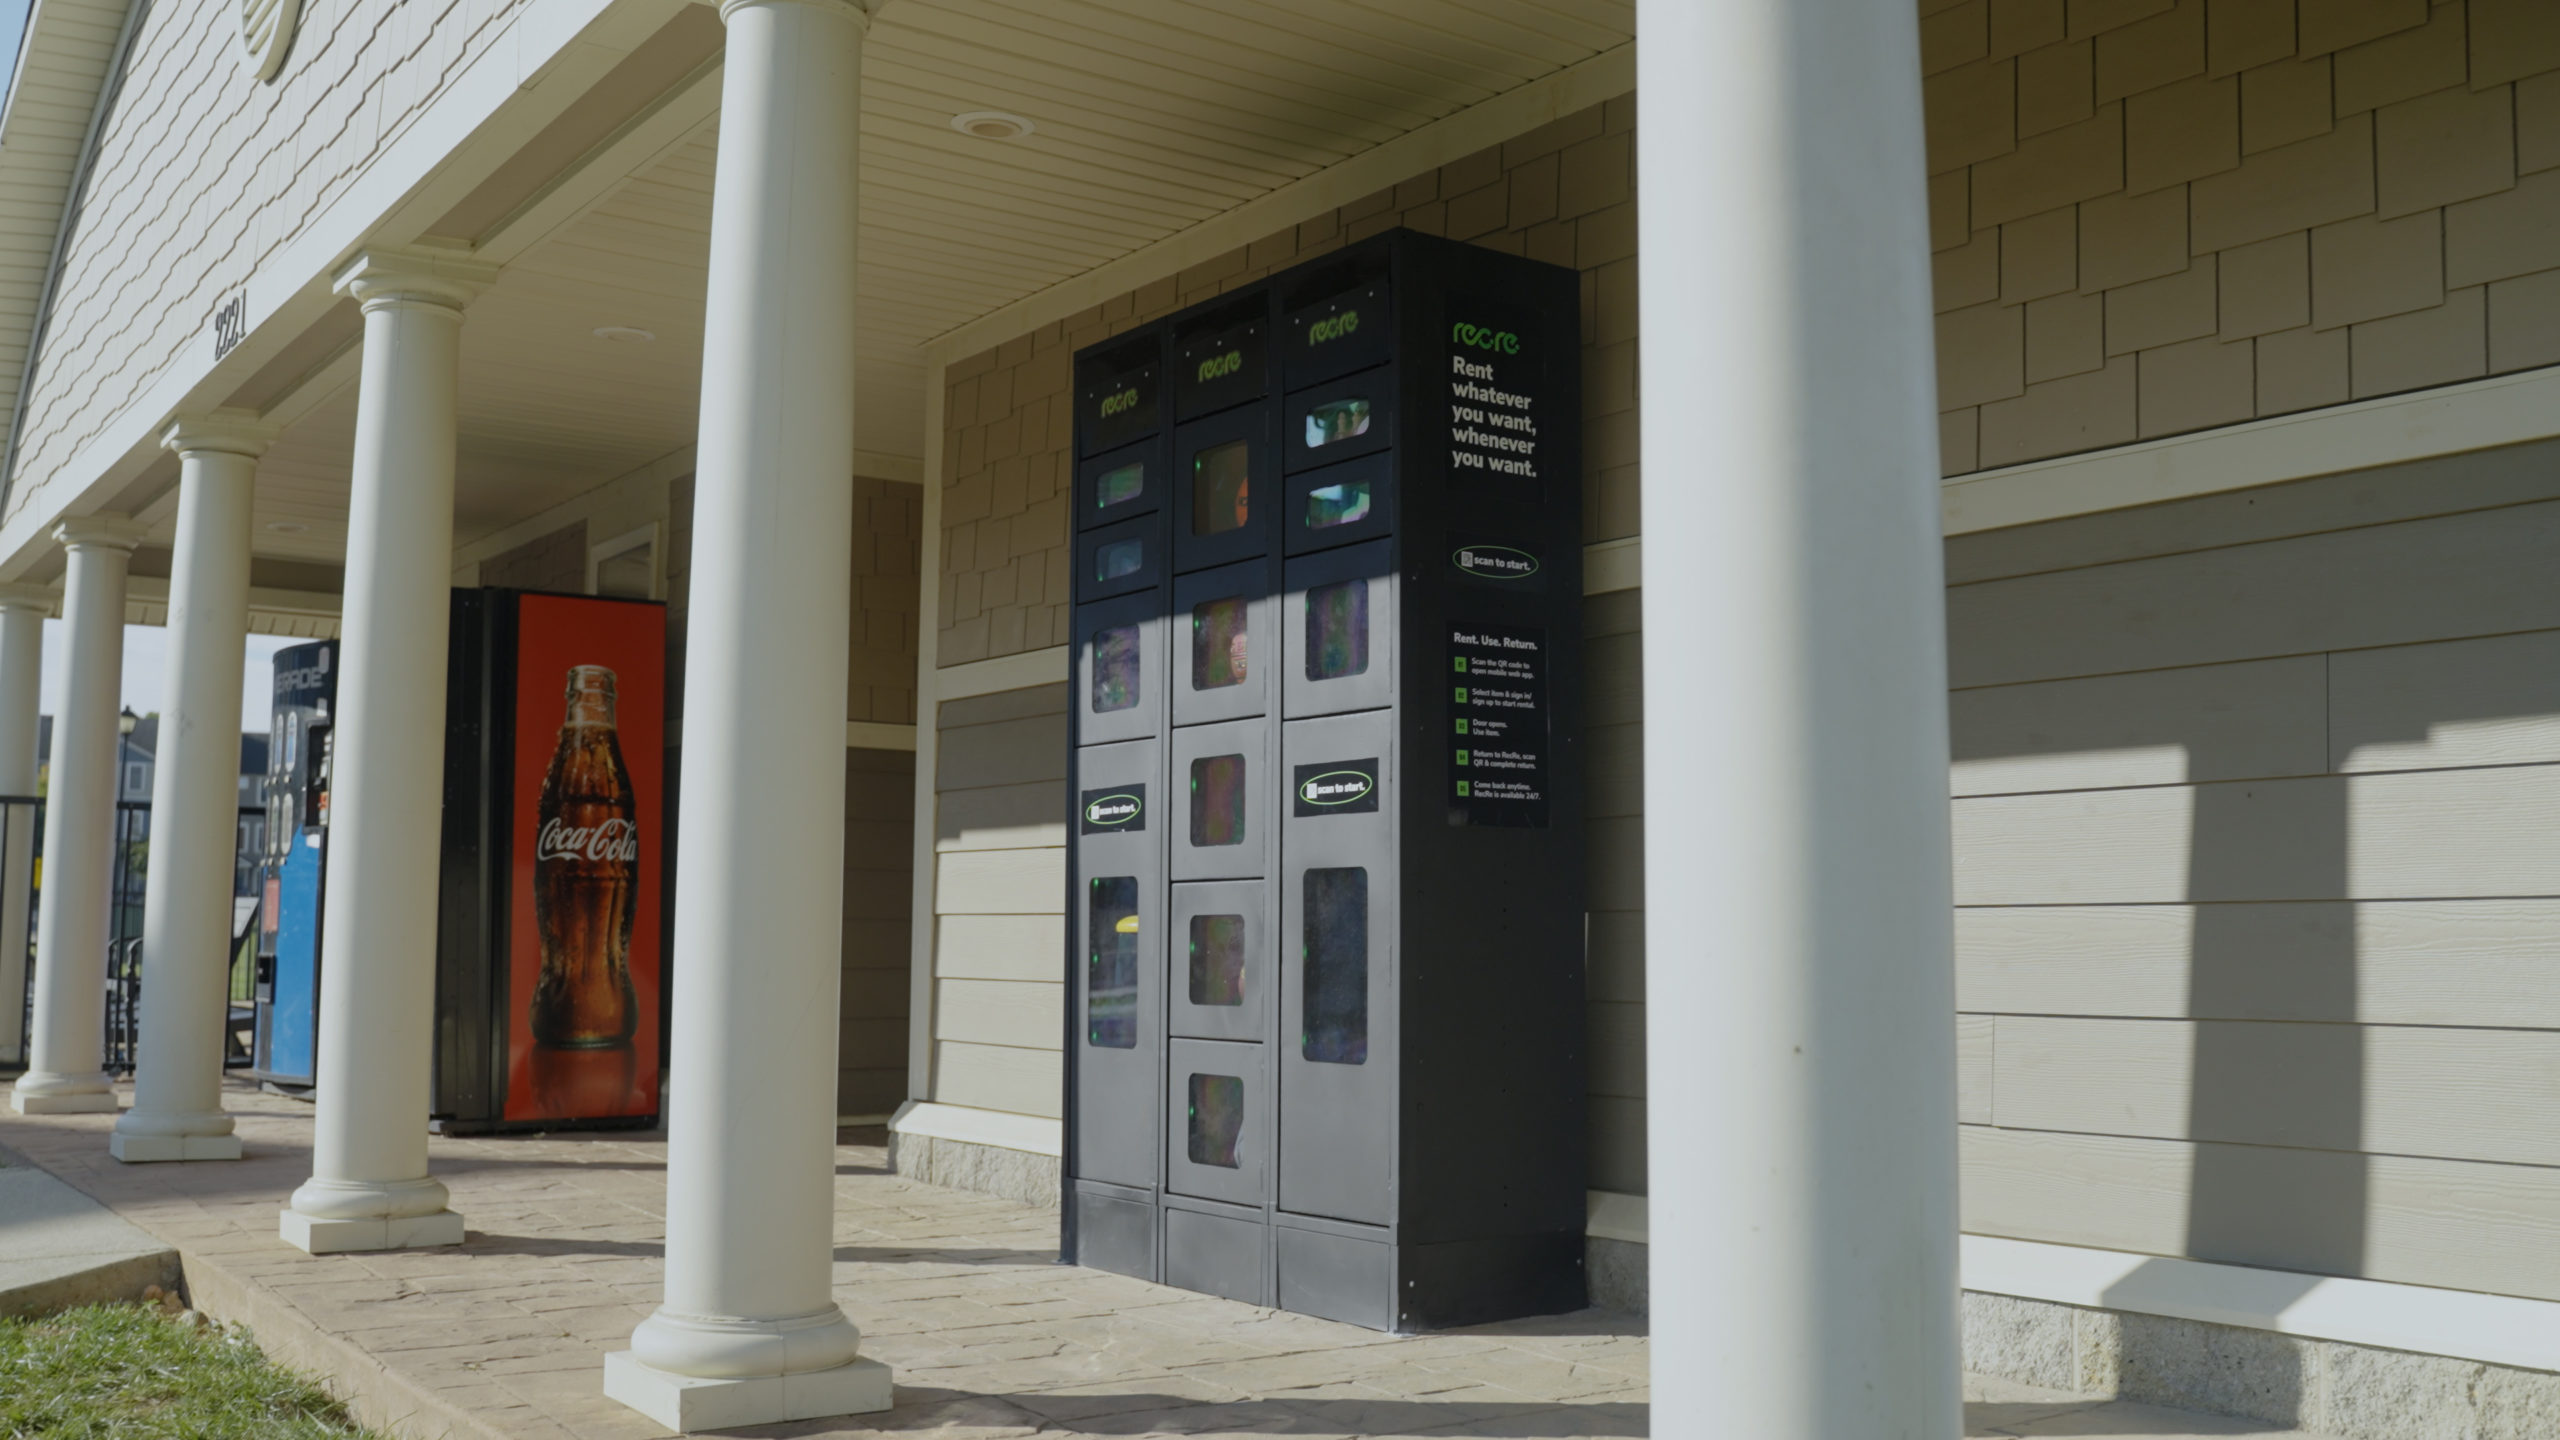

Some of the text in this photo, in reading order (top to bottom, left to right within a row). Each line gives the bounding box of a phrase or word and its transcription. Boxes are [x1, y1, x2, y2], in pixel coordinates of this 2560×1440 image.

[215, 288, 246, 361] 2221
[1309, 310, 1358, 346] recre
[1453, 322, 1520, 355] recre
[1453, 356, 1493, 381] Rent
[1452, 381, 1531, 410] whatever
[1452, 405, 1536, 436] you want,
[1452, 426, 1535, 454] whenever
[1452, 450, 1537, 477] you want.
[1474, 557, 1531, 571] scan to start.
[1454, 631, 1538, 650] Rent. Use. Return.
[538, 817, 637, 861] Coca-Cola
